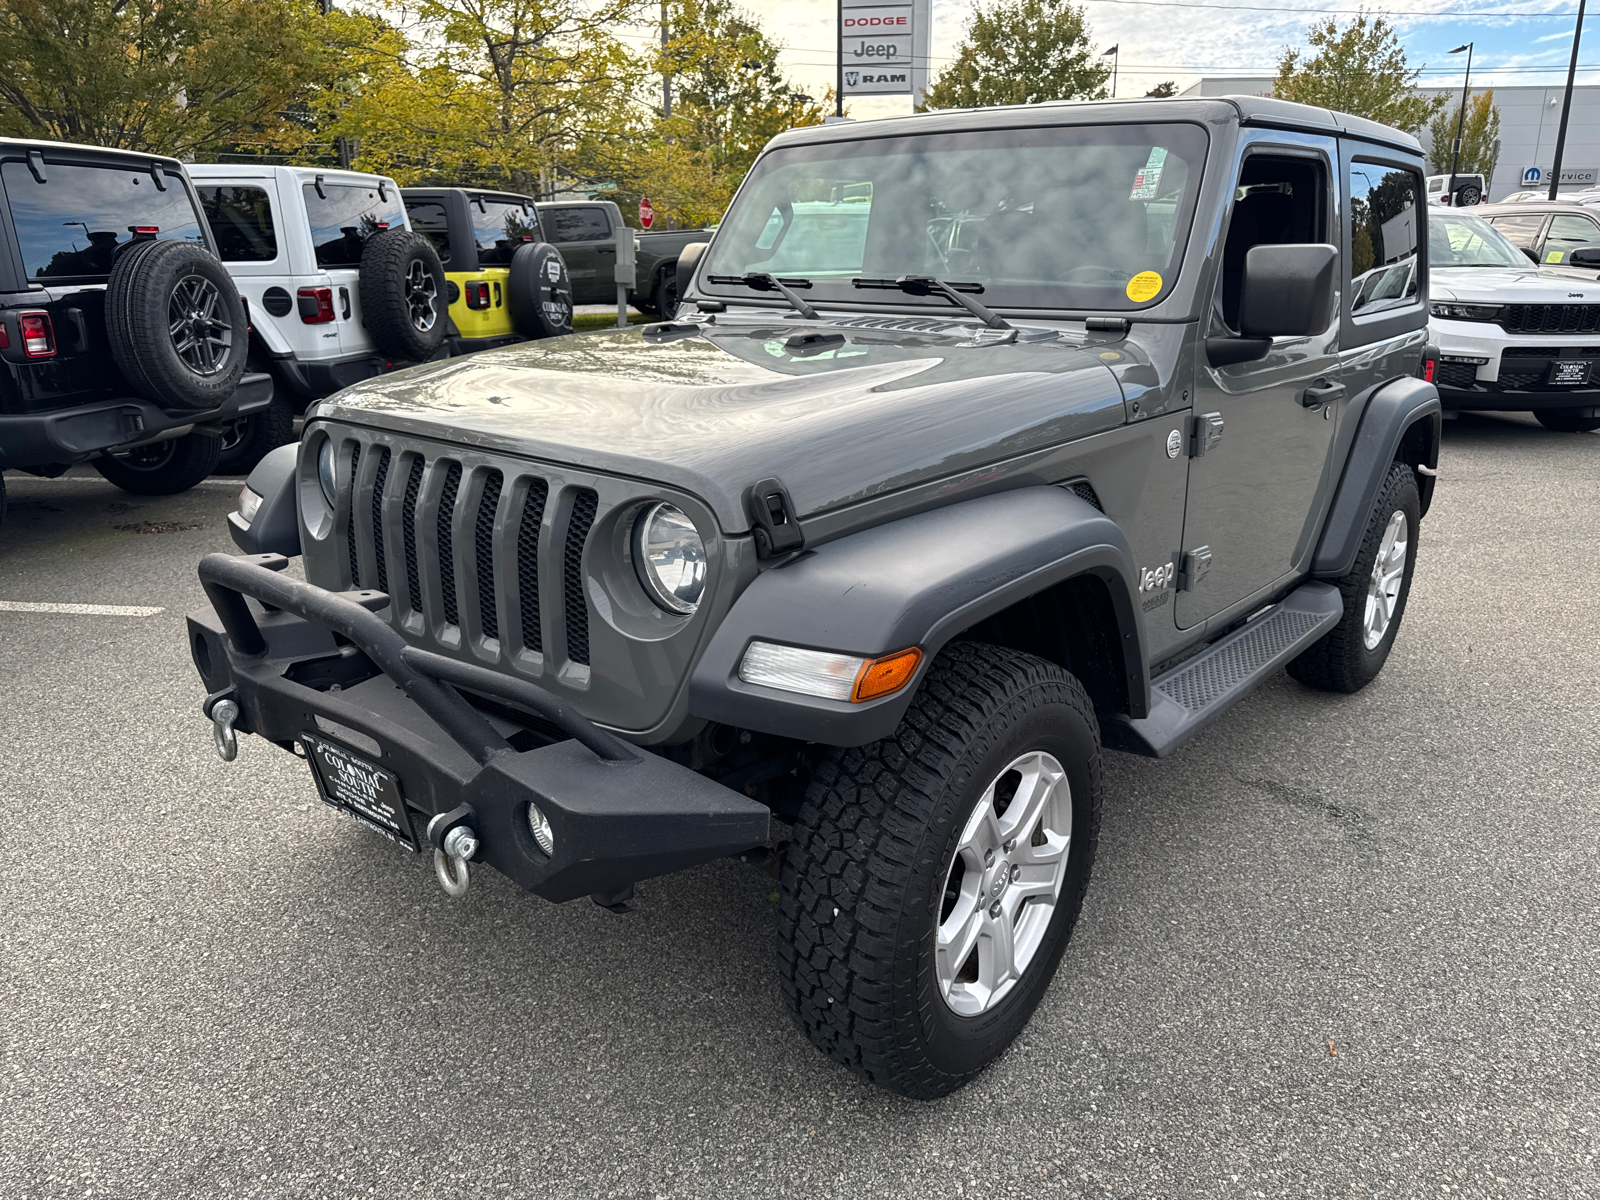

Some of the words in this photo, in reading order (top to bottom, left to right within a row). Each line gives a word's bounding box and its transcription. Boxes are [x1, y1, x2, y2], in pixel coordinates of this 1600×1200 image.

[844, 17, 907, 27] DODGE
[853, 41, 897, 60] Jeep
[862, 74, 906, 83] RAM
[1546, 171, 1592, 180] Srvice
[640, 206, 654, 219] STOP
[1139, 562, 1174, 593] Jeep
[324, 752, 384, 791] COLONIAL
[329, 775, 375, 803] CHRYSLER
[338, 769, 377, 799] SOUTH
[337, 785, 366, 805] DODGE
